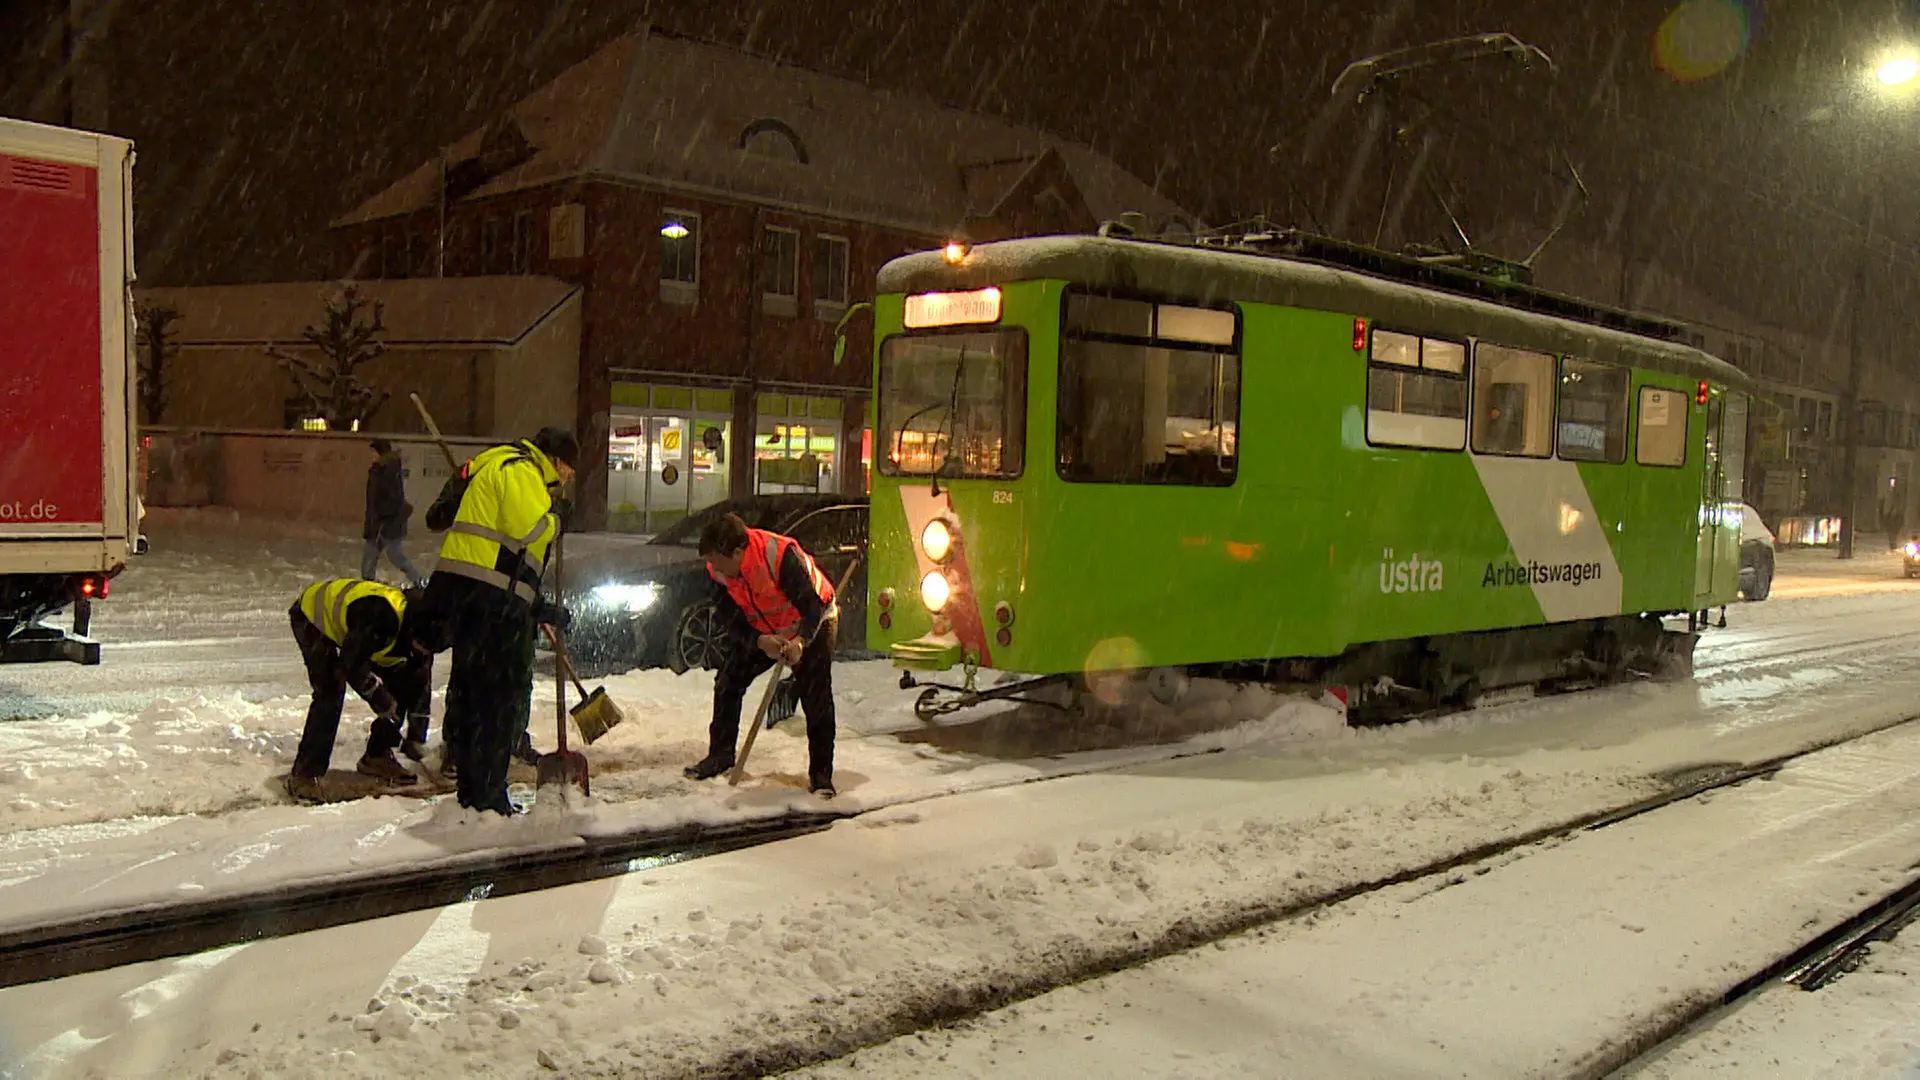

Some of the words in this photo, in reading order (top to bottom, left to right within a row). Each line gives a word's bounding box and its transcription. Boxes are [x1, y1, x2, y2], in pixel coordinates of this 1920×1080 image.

[992, 490, 1013, 504] 824
[1380, 548, 1443, 594] üstra
[1481, 559, 1601, 588] Arbeitswagen
